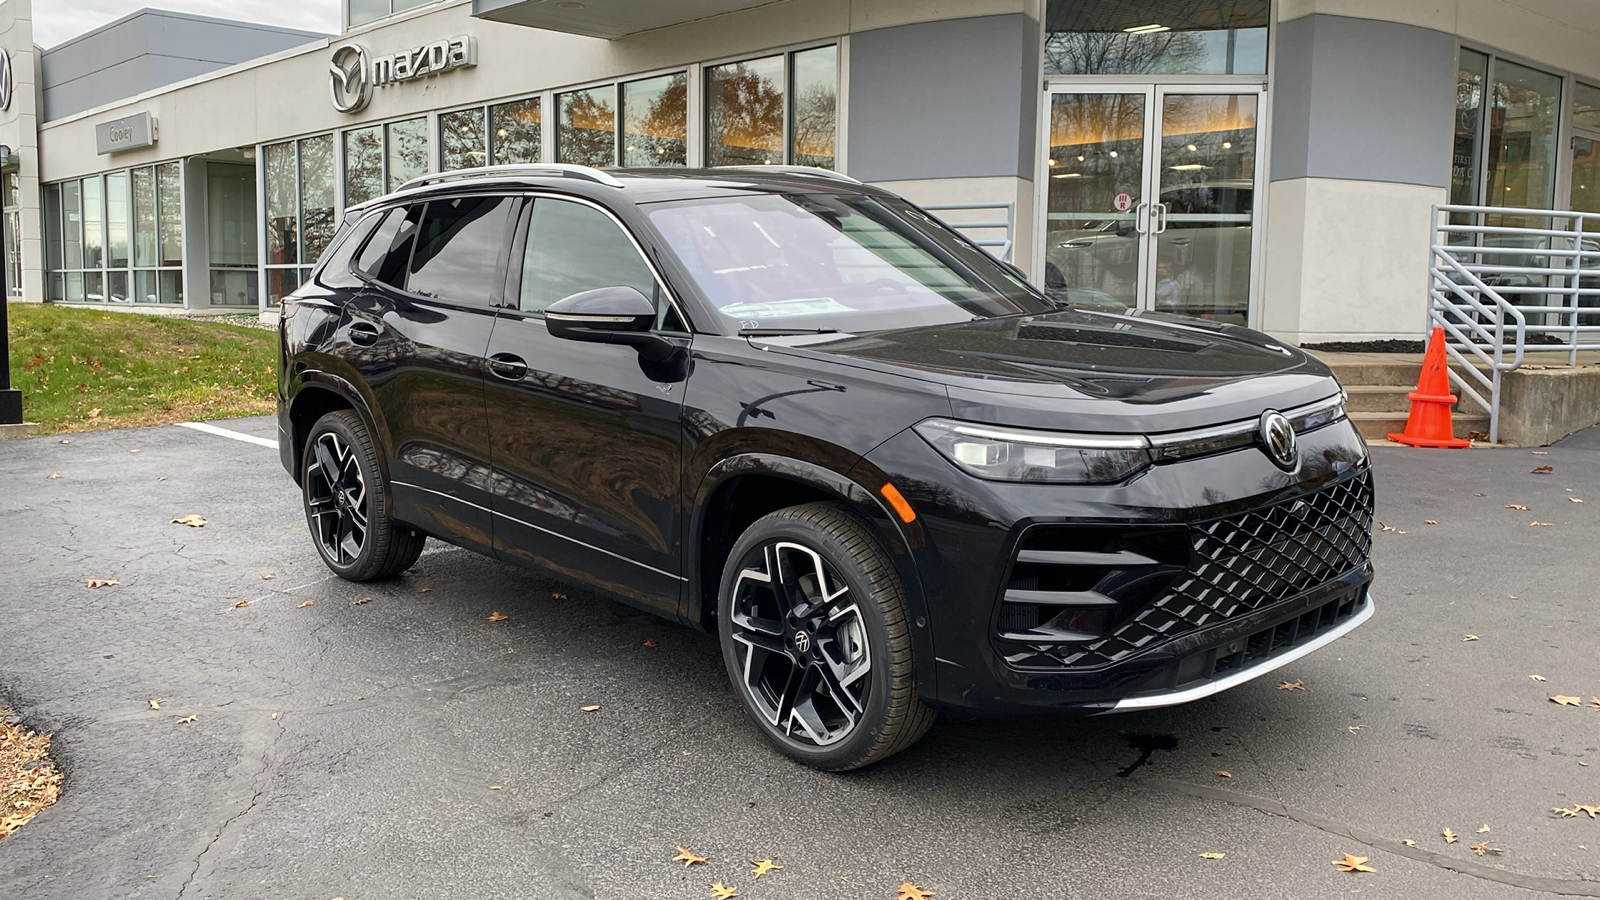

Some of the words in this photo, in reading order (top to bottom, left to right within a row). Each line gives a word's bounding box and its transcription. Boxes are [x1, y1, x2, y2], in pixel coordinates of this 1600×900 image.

[372, 34, 477, 87] mazda
[109, 121, 133, 144] Cooley
[1454, 154, 1472, 165] FIRST
